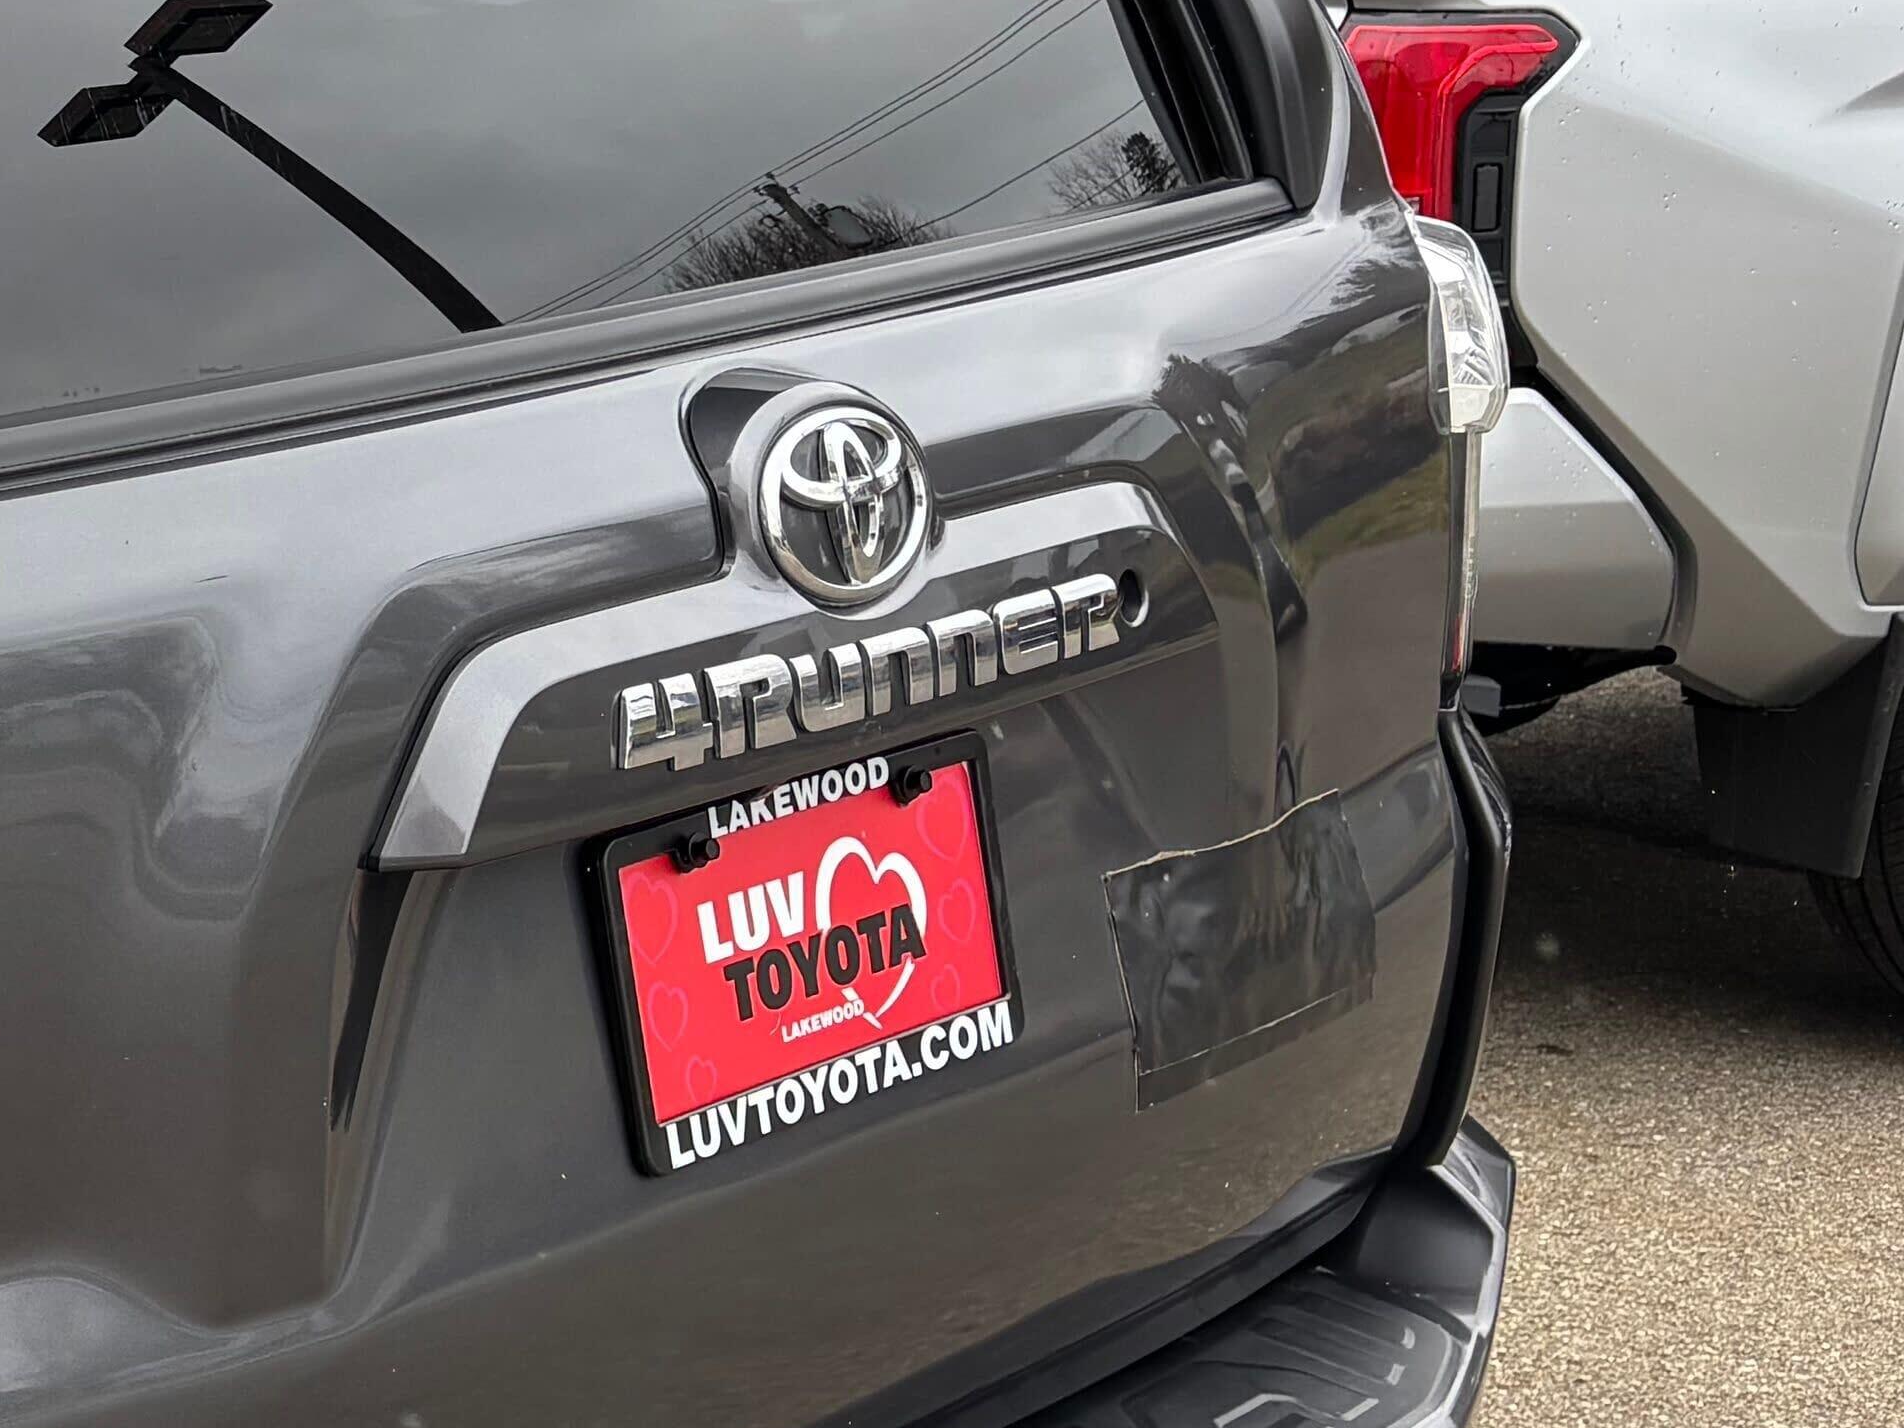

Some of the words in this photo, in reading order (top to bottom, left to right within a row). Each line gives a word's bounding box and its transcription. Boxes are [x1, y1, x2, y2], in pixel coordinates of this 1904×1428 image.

[707, 756, 890, 839] LAKEWOOD
[696, 871, 804, 964] LUV
[722, 904, 927, 1024] TOYOTA
[781, 999, 866, 1044] LAKEWOOD
[665, 1001, 1014, 1171] LUVTOYOTA.COM
